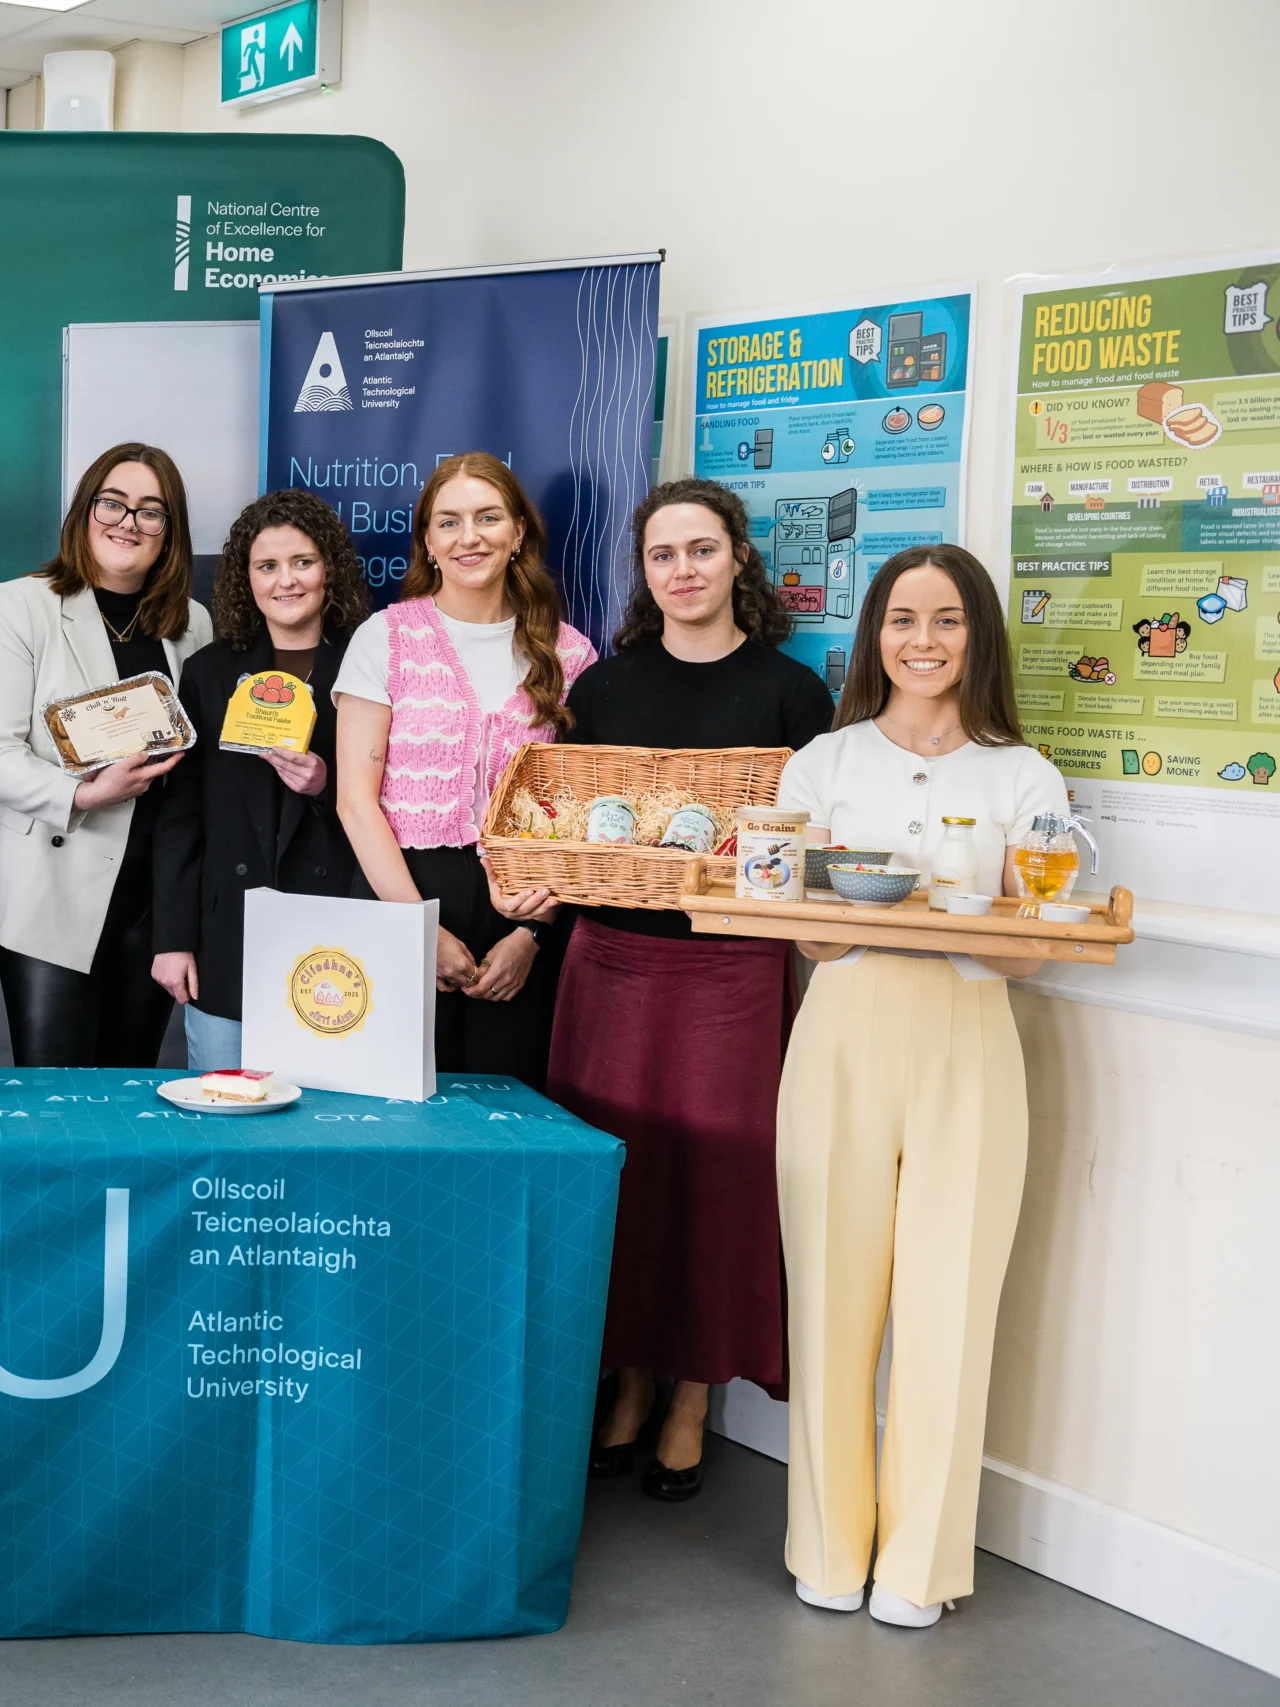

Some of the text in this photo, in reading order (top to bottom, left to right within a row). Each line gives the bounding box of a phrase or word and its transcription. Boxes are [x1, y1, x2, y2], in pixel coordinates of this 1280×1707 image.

[207, 202, 320, 218] National Centre
[206, 222, 325, 237] of Excellence for
[206, 241, 274, 262] Home
[1233, 293, 1257, 306] BEST
[1233, 305, 1257, 313] PRACTICE
[1035, 294, 1152, 338] REDUCING
[1233, 313, 1256, 327] TIPS
[365, 329, 392, 338] Ollscoil
[856, 328, 875, 339] BEST
[364, 339, 424, 349] Teicneolaíochta
[856, 338, 874, 346] PRACTICE
[707, 329, 802, 367] STORAGE &
[856, 346, 874, 356] TIPS
[1033, 330, 1181, 375] FOOD WASTE
[375, 351, 414, 361] Atlantaigh
[363, 376, 392, 384] Atlantic
[706, 358, 843, 399] REFRIGERATION
[1062, 377, 1093, 389] manage
[1096, 374, 1114, 383] food
[1117, 373, 1132, 382] and
[1134, 371, 1153, 380] food
[1156, 370, 1179, 378] waste
[362, 386, 415, 396] Technological
[362, 399, 400, 408] University
[728, 400, 750, 410] manage
[752, 398, 766, 406] food
[768, 397, 779, 405] and
[781, 395, 800, 405] fridge
[1047, 398, 1130, 412] DID YOU KNOW?
[700, 417, 759, 429] HANDLING FOOD
[1045, 416, 1068, 444] 1/3
[1021, 457, 1187, 474] WHERE & HOW IS FOOD WASTED?
[290, 456, 425, 492] Nutrition,
[751, 481, 765, 489] TIPS
[1070, 482, 1109, 491] MANUFACTURE
[1131, 480, 1169, 489] DISTRIBUTION
[1200, 478, 1219, 486] RETAIL
[1028, 485, 1042, 493] FARM
[351, 502, 412, 533] Busi
[1068, 512, 1130, 521] DEVELOPING COUNTRIES
[1017, 561, 1109, 571] BEST PRACTICE TIPS
[1082, 603, 1112, 611] cupboards
[1084, 619, 1112, 627] shopping.
[86, 701, 100, 711] Chill
[255, 708, 278, 716] Shaun's
[246, 713, 291, 724] Traditional Falafel
[1020, 725, 1054, 735] DUCING
[1057, 727, 1084, 737] FOOD
[1088, 729, 1122, 739] WASTE
[1125, 731, 1134, 740] IS
[1054, 748, 1106, 759] CONSERVING
[1053, 759, 1100, 769] RESOURCES
[1167, 756, 1200, 765] SAVING
[1167, 768, 1200, 777] MONEY
[762, 824, 796, 832] Grains
[135, 1111, 201, 1120] ATU
[314, 1113, 381, 1121] OTA
[192, 1178, 285, 1201] Ollscoil
[192, 1209, 391, 1238] Teicneolaíochta
[189, 1243, 357, 1273] an Atlantaigh
[188, 1310, 283, 1333] Atlantic
[188, 1343, 362, 1373] Technological
[187, 1375, 309, 1403] University
